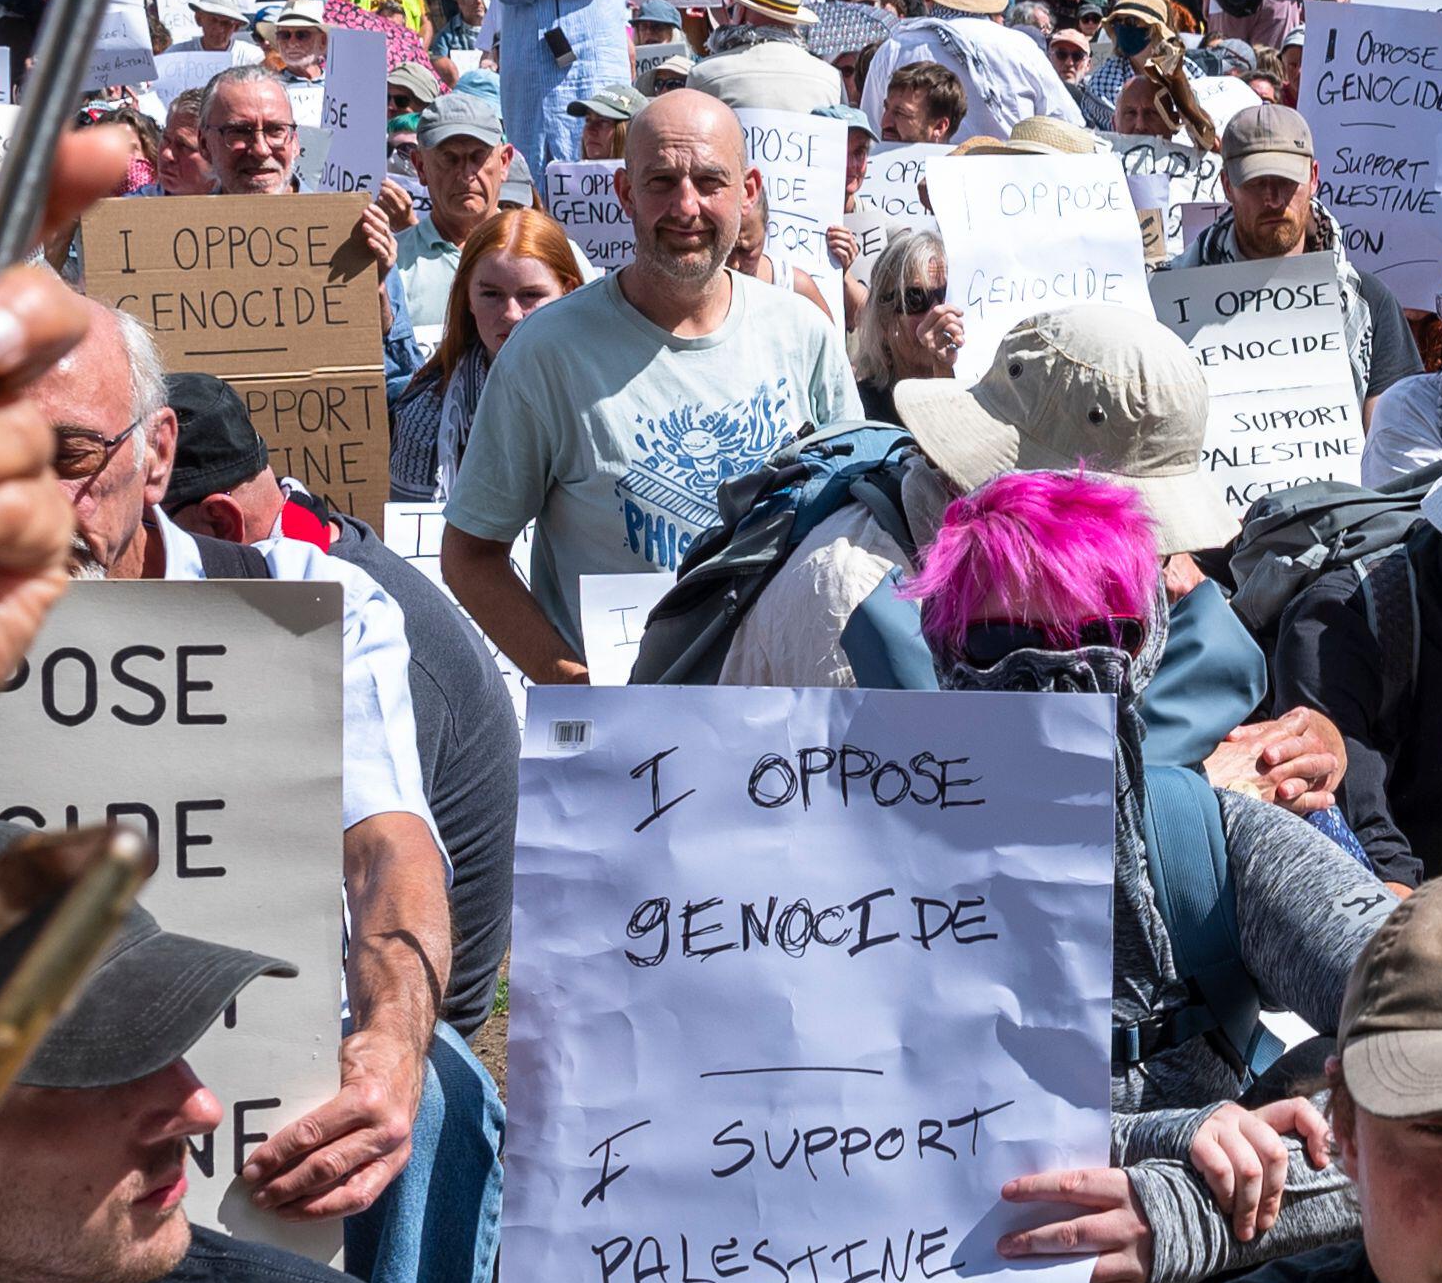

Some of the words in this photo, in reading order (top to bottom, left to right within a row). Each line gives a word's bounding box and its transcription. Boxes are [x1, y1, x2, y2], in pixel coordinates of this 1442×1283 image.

[1325, 28, 1338, 64] I
[553, 174, 573, 197] I
[1332, 146, 1431, 183] SUPPORT
[999, 180, 1128, 220] OPPOSE
[121, 229, 137, 274] I
[172, 223, 333, 270] OPPOSE
[115, 283, 351, 334] GENOCIDE
[966, 266, 1124, 318] GENOCIDE
[1173, 296, 1195, 325] I
[1214, 282, 1340, 315] OPPOSE
[1229, 403, 1351, 435] SUPPORT
[395, 512, 445, 559] I
[608, 605, 639, 648] I
[629, 746, 697, 833] I
[746, 744, 988, 812] OPPOSE
[580, 1118, 653, 1208] I
[709, 1099, 1016, 1183] SUPPORT
